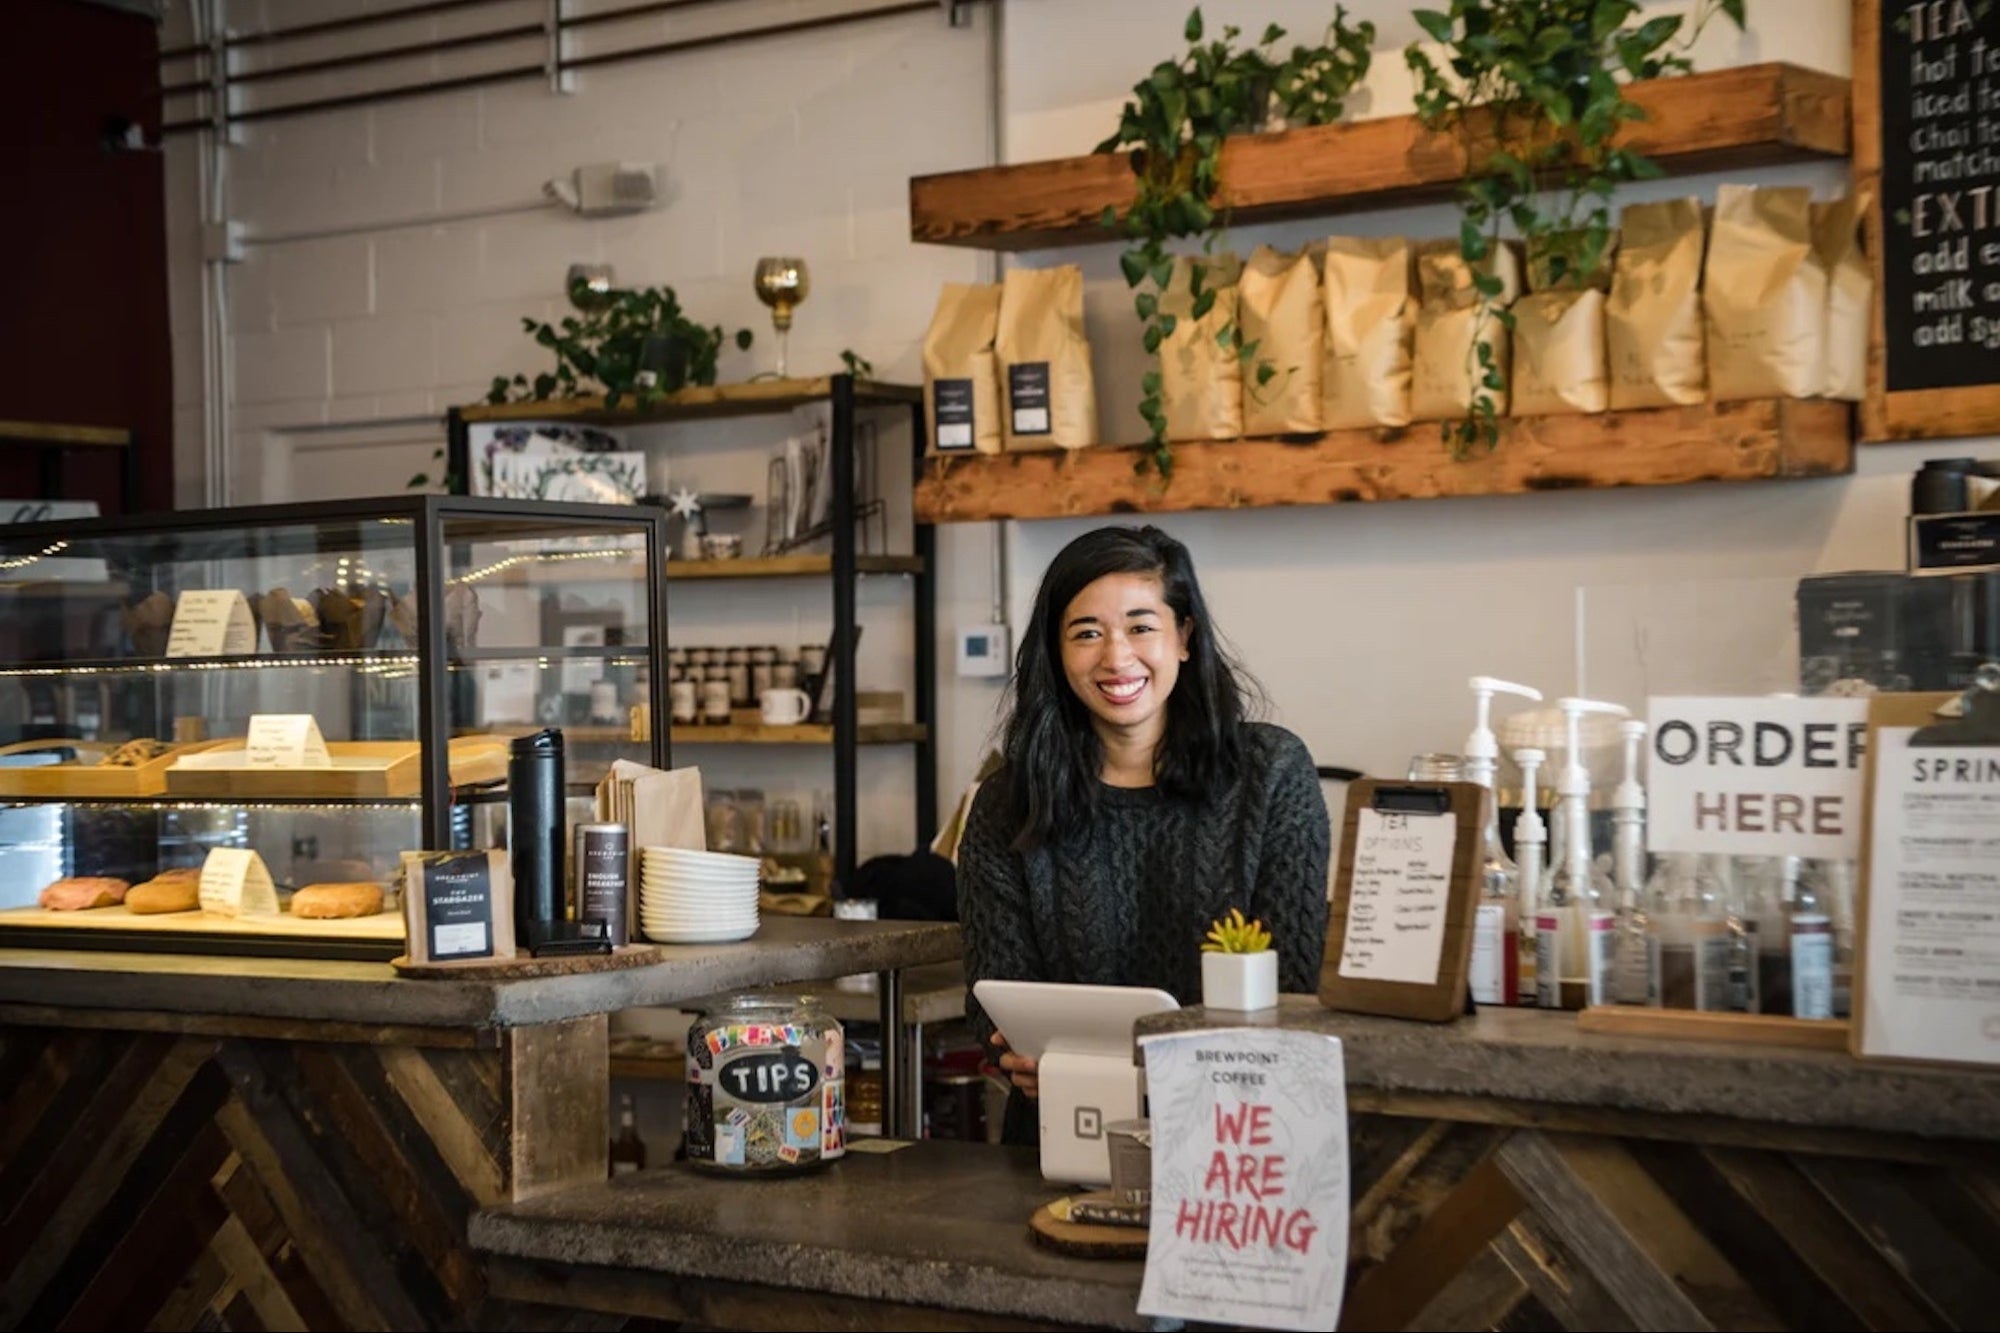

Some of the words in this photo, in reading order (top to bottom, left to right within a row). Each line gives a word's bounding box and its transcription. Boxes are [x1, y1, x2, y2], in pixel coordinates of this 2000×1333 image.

[1905, 0, 1973, 43] TEA
[1911, 43, 1957, 85] hot
[1912, 82, 1970, 118] iced
[1912, 235, 1969, 275] add
[1912, 313, 1963, 347] add
[1381, 813, 1408, 830] TEA
[1695, 792, 1843, 835] HERE
[1364, 836, 1423, 853] OPTIONS
[1196, 1050, 1279, 1065] BREWPOINT
[732, 1063, 811, 1094] TIPS
[1212, 1072, 1267, 1086] COFFEE
[1215, 1102, 1273, 1145] WE
[1204, 1150, 1285, 1202] ARE
[1176, 1198, 1318, 1256] HIRING
